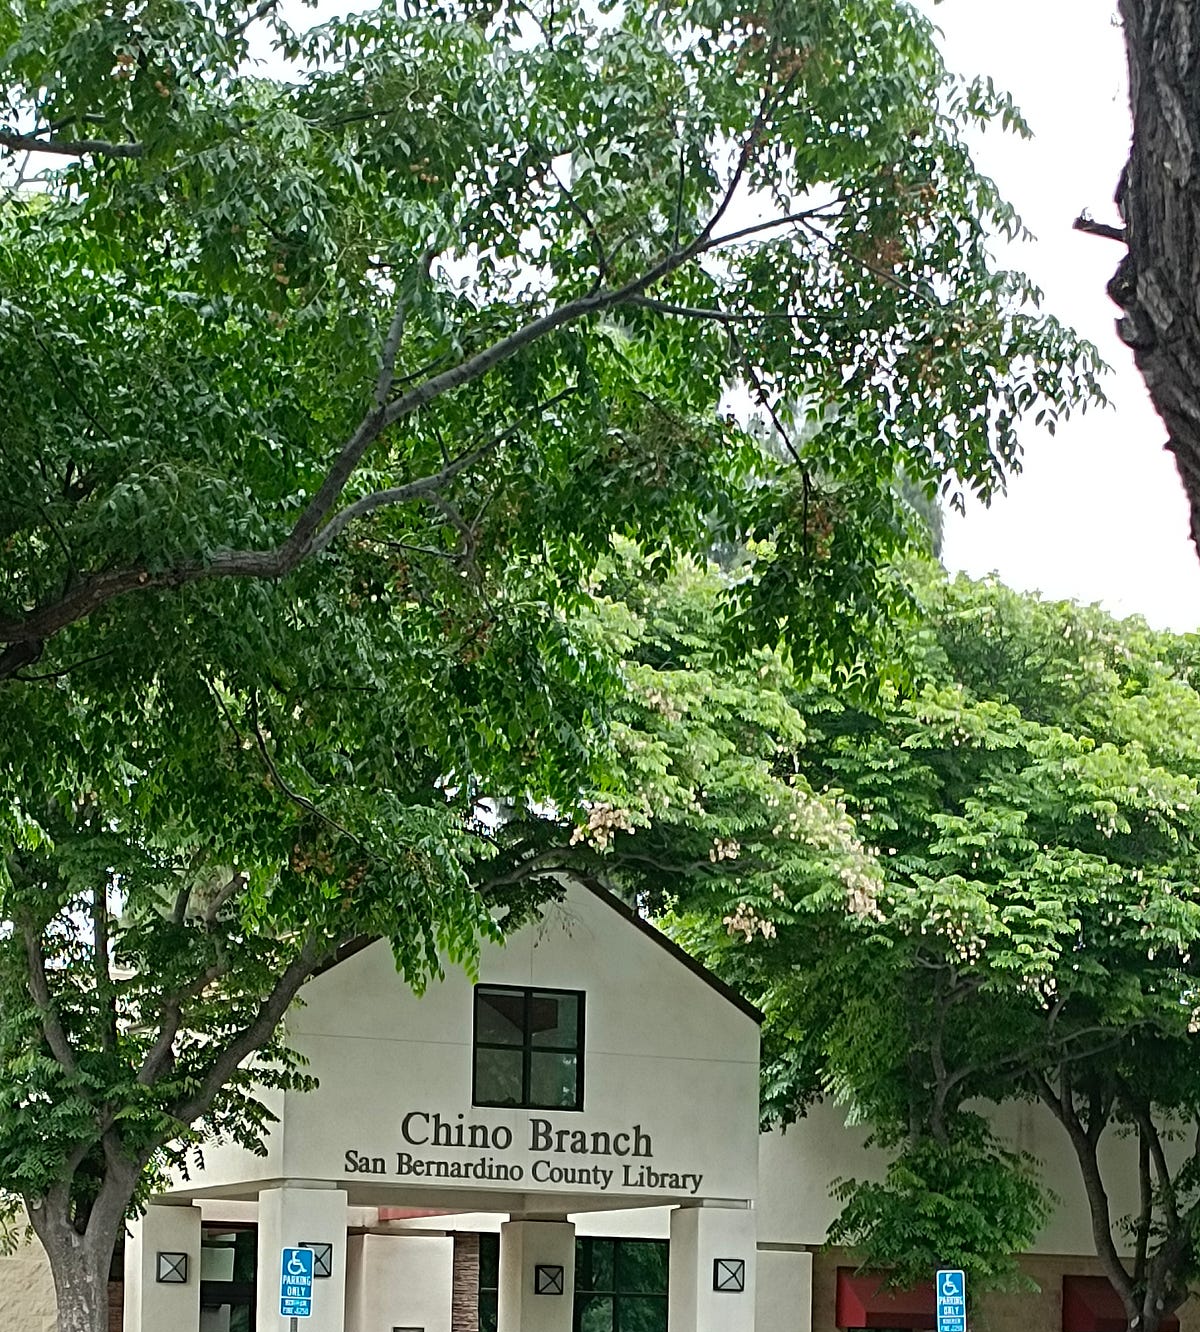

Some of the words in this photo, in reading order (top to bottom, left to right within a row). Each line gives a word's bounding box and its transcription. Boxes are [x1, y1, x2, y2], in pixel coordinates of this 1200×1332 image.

[401, 1111, 513, 1150] Chino
[528, 1118, 653, 1157] Branch
[344, 1150, 387, 1174] San
[395, 1152, 524, 1181] Bernardino
[531, 1160, 613, 1190] County
[622, 1164, 703, 1194] Library
[282, 1274, 311, 1287] PARKING
[287, 1286, 305, 1297] ONLY
